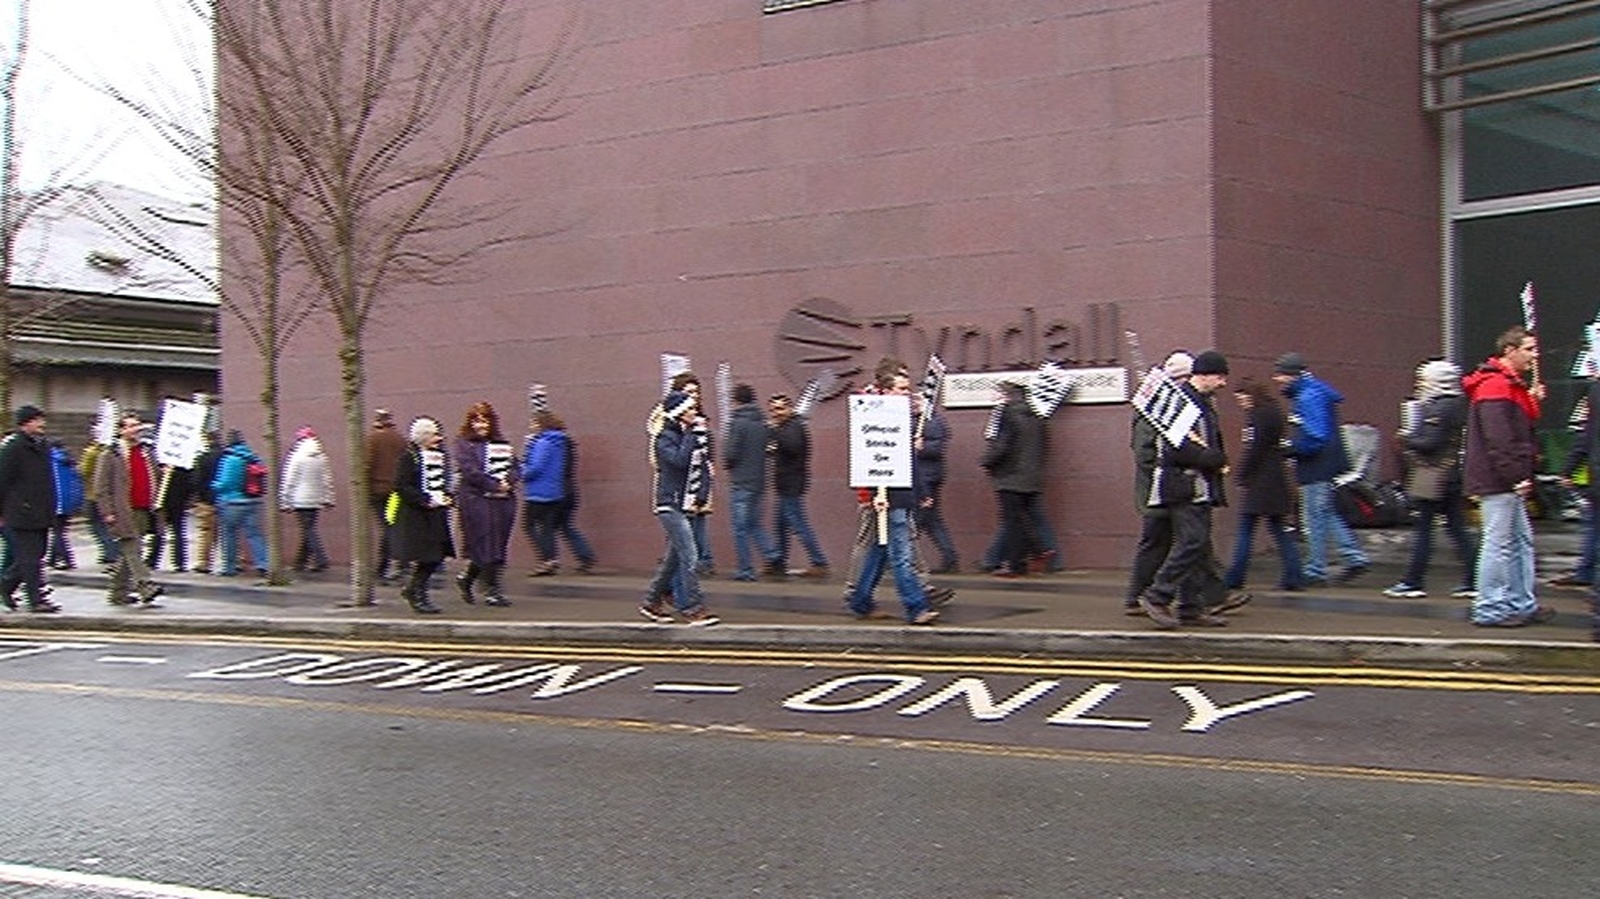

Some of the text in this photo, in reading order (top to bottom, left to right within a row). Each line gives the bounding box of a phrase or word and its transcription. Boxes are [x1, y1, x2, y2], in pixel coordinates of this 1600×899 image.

[866, 303, 1119, 374] Tyndall
[186, 653, 643, 699] DOWN
[781, 674, 1313, 733] ONLY
